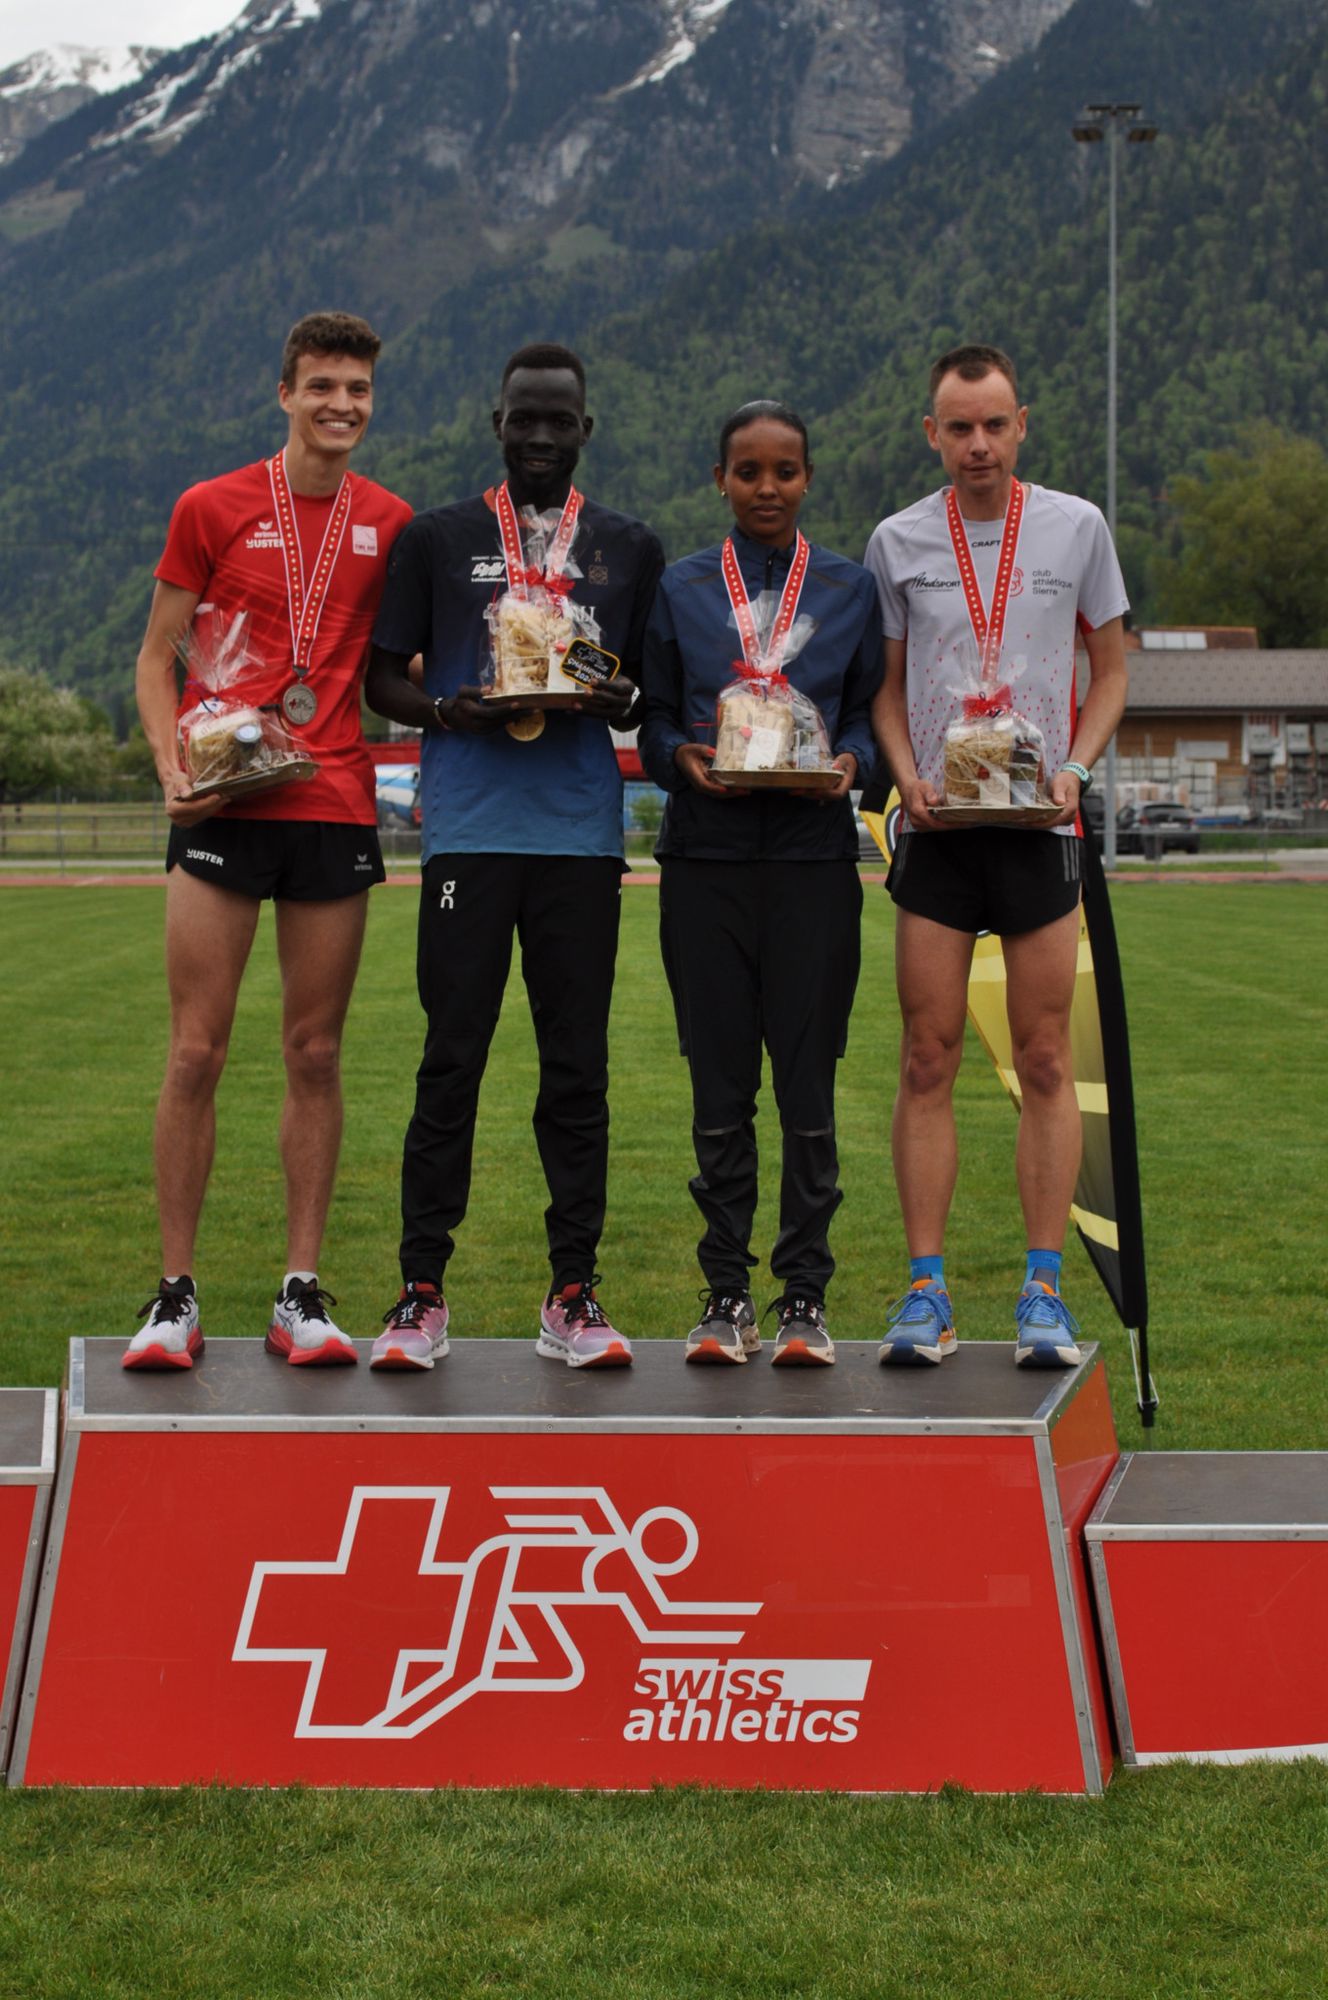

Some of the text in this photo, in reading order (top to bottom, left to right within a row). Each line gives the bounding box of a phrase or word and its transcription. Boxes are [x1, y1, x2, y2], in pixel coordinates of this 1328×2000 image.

[971, 539, 1001, 548] CRAFT
[1032, 569, 1052, 577] club
[1032, 587, 1058, 596] Sierre
[634, 1658, 785, 1701] swiss
[622, 1699, 861, 1743] athletics
